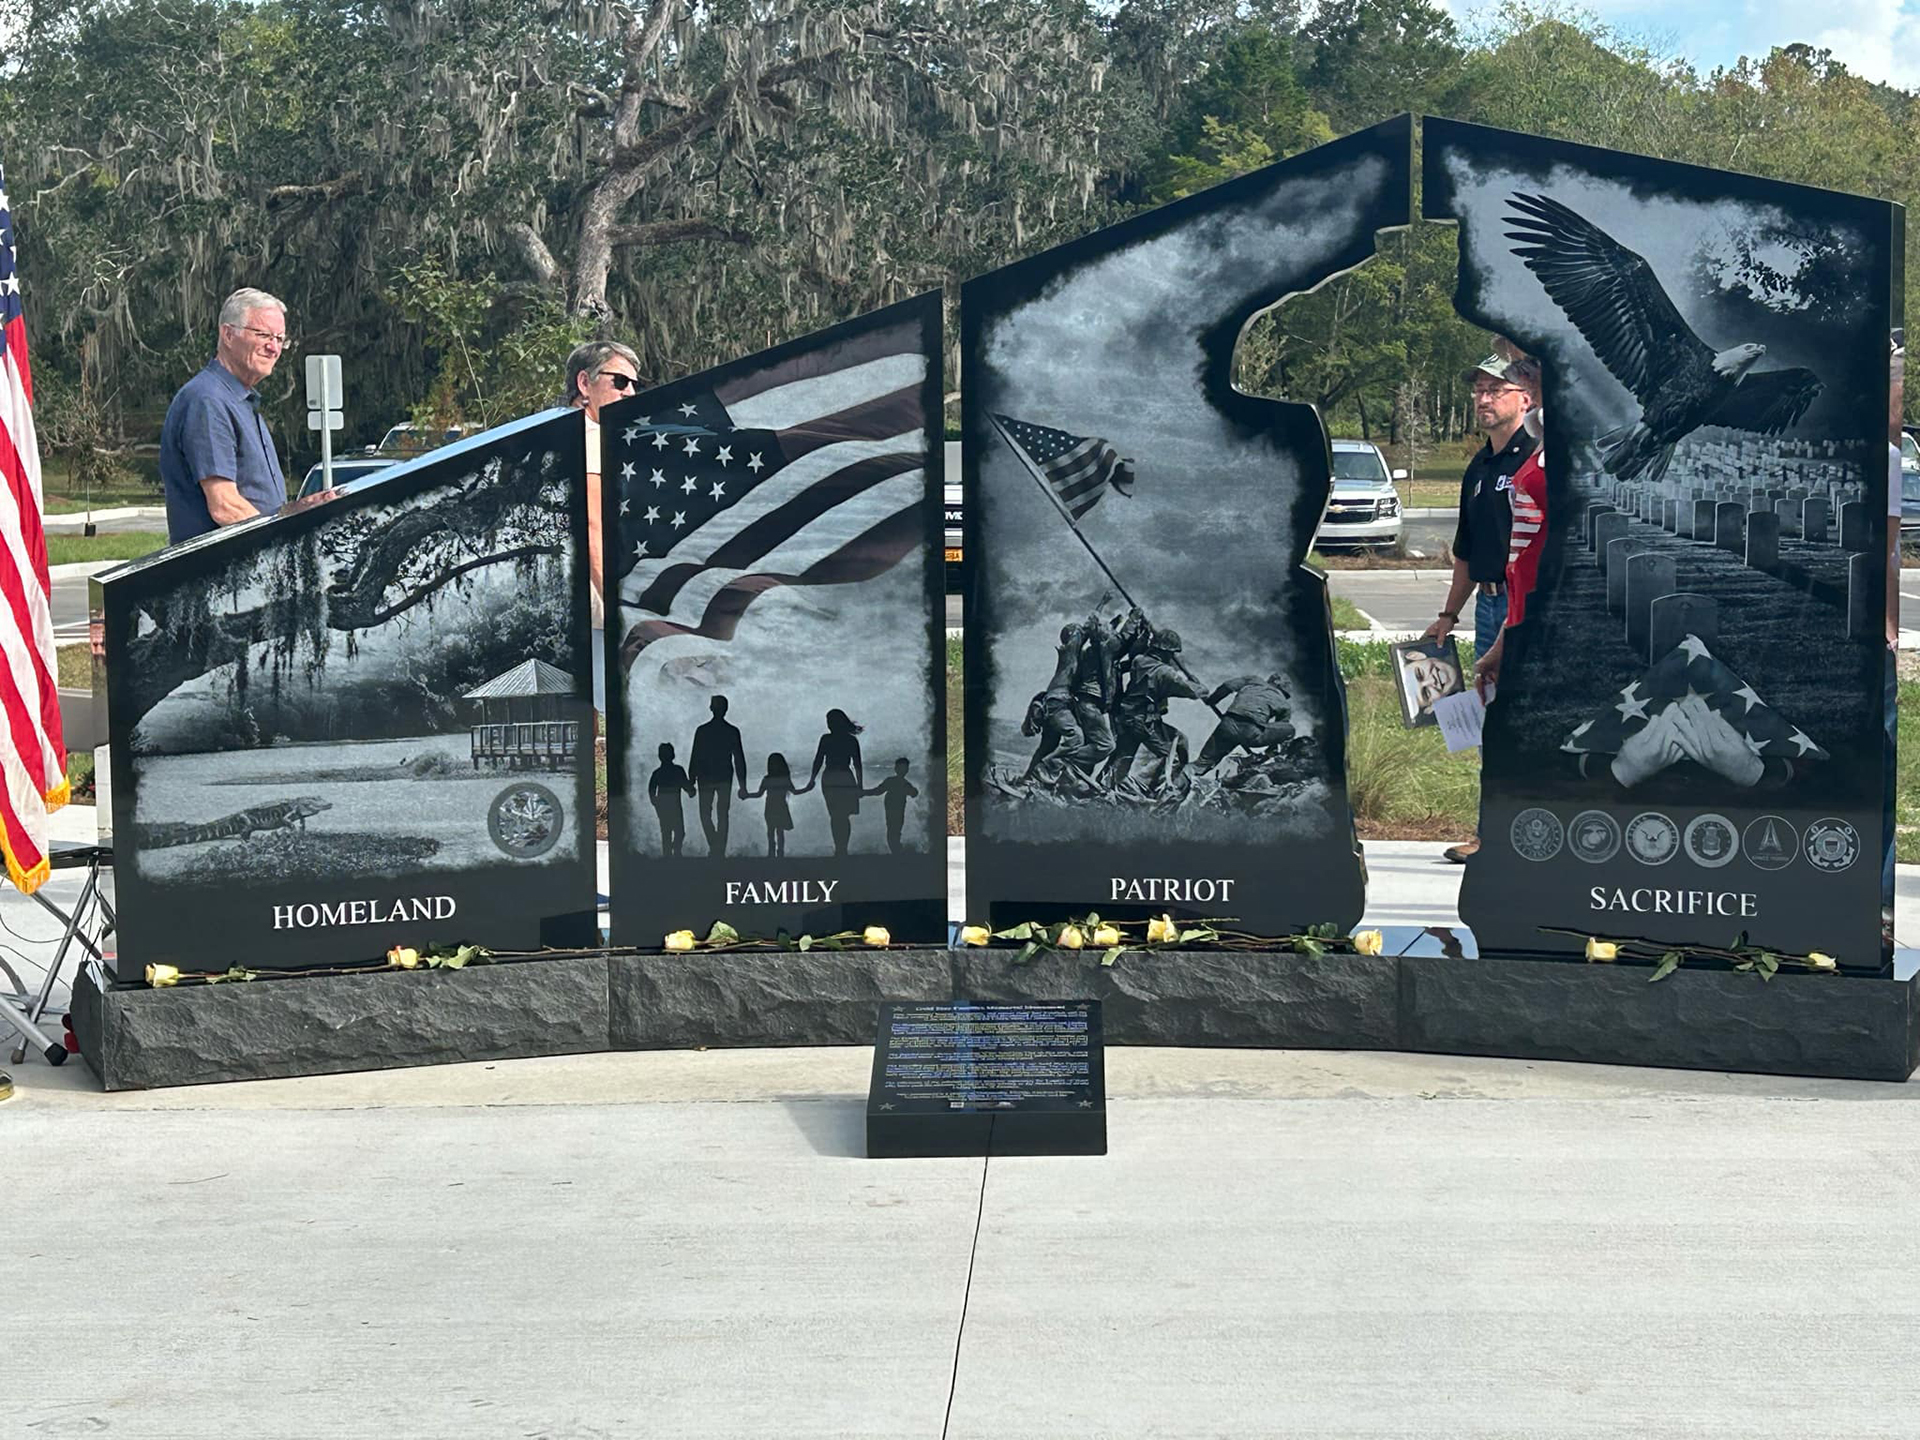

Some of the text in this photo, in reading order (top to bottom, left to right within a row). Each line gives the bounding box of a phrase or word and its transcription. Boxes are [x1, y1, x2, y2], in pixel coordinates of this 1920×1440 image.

[726, 881, 838, 904] FAMILY
[1111, 878, 1234, 901] PATRIOT
[1591, 887, 1757, 916] SACRIFICE
[273, 896, 456, 929] HOMELAND
